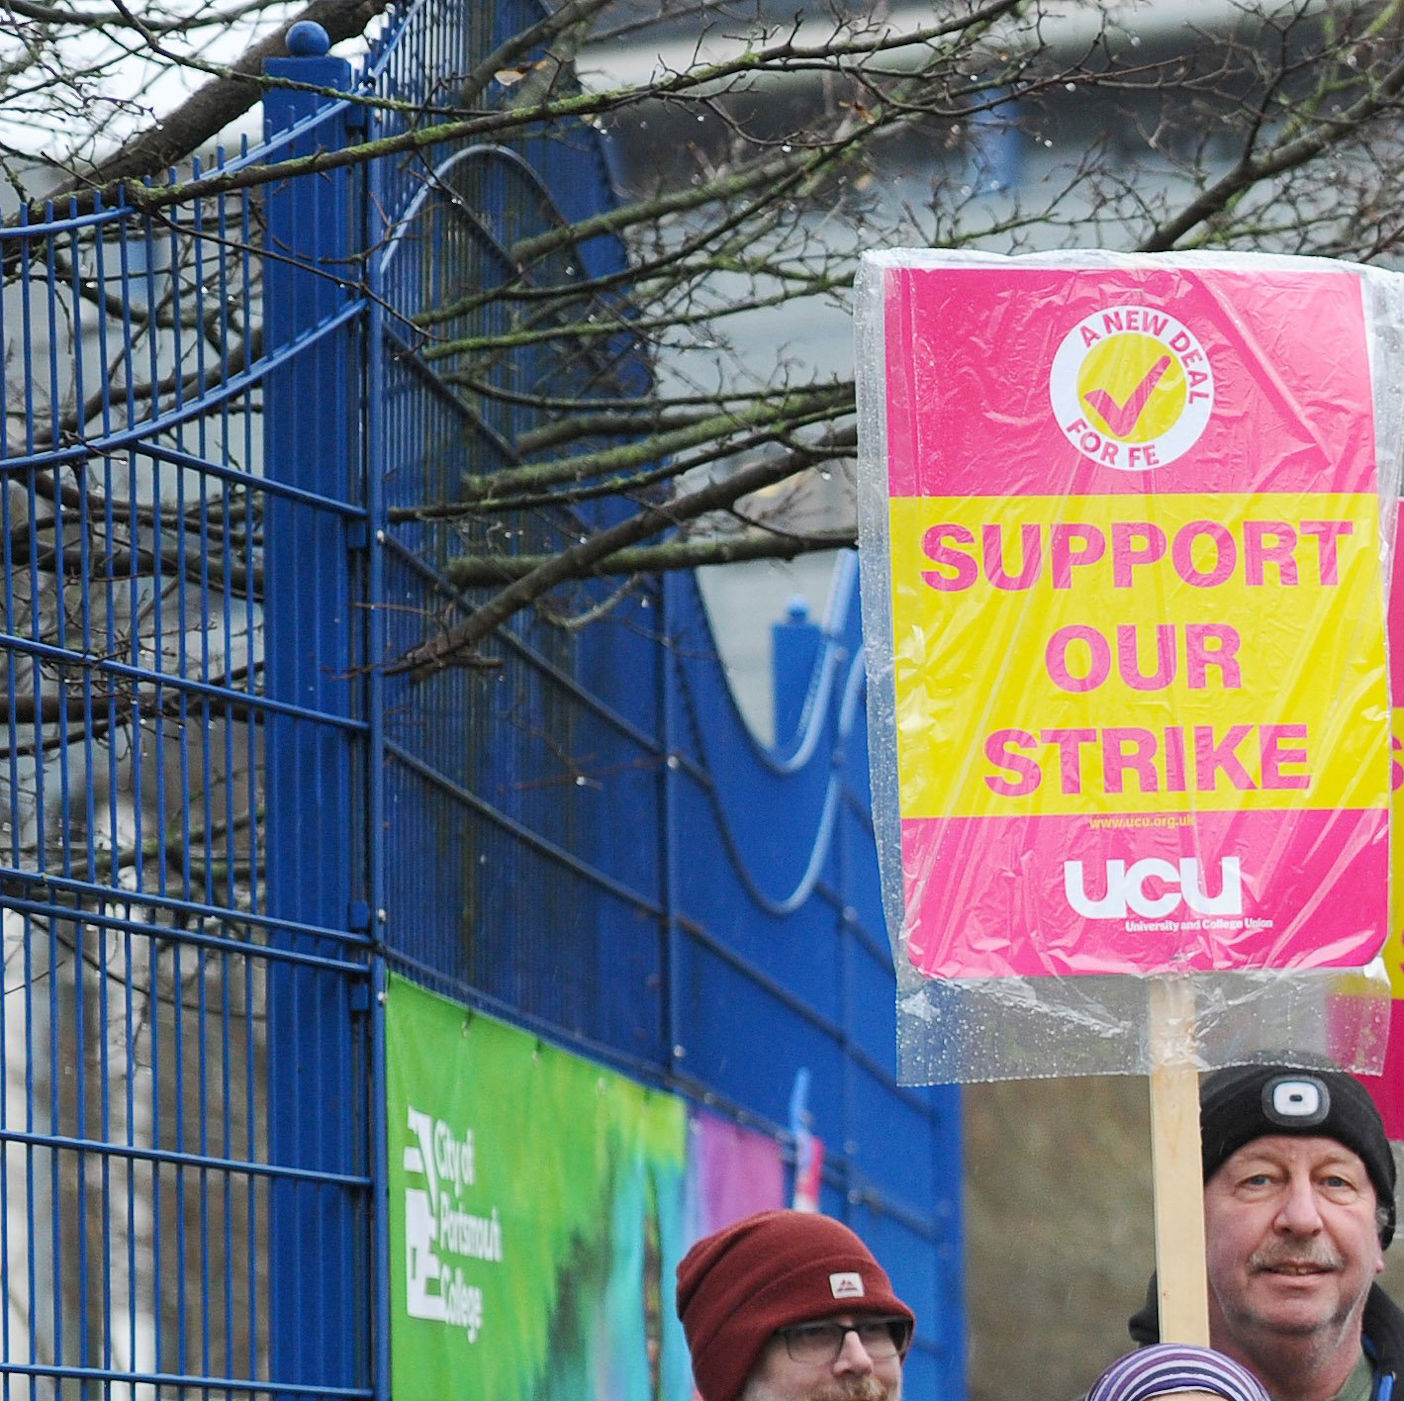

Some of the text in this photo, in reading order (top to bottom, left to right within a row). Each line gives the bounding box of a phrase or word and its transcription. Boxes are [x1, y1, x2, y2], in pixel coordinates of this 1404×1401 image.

[1080, 310, 1209, 404] A NEW DEAL
[1066, 418, 1160, 467] FOR FE
[921, 520, 1354, 591] SUPPORT
[1045, 623, 1241, 693] OUR
[984, 723, 1311, 796] STRIKE
[1090, 815, 1195, 828] www.ucu.org.uk
[1126, 918, 1272, 932] University and College Union
